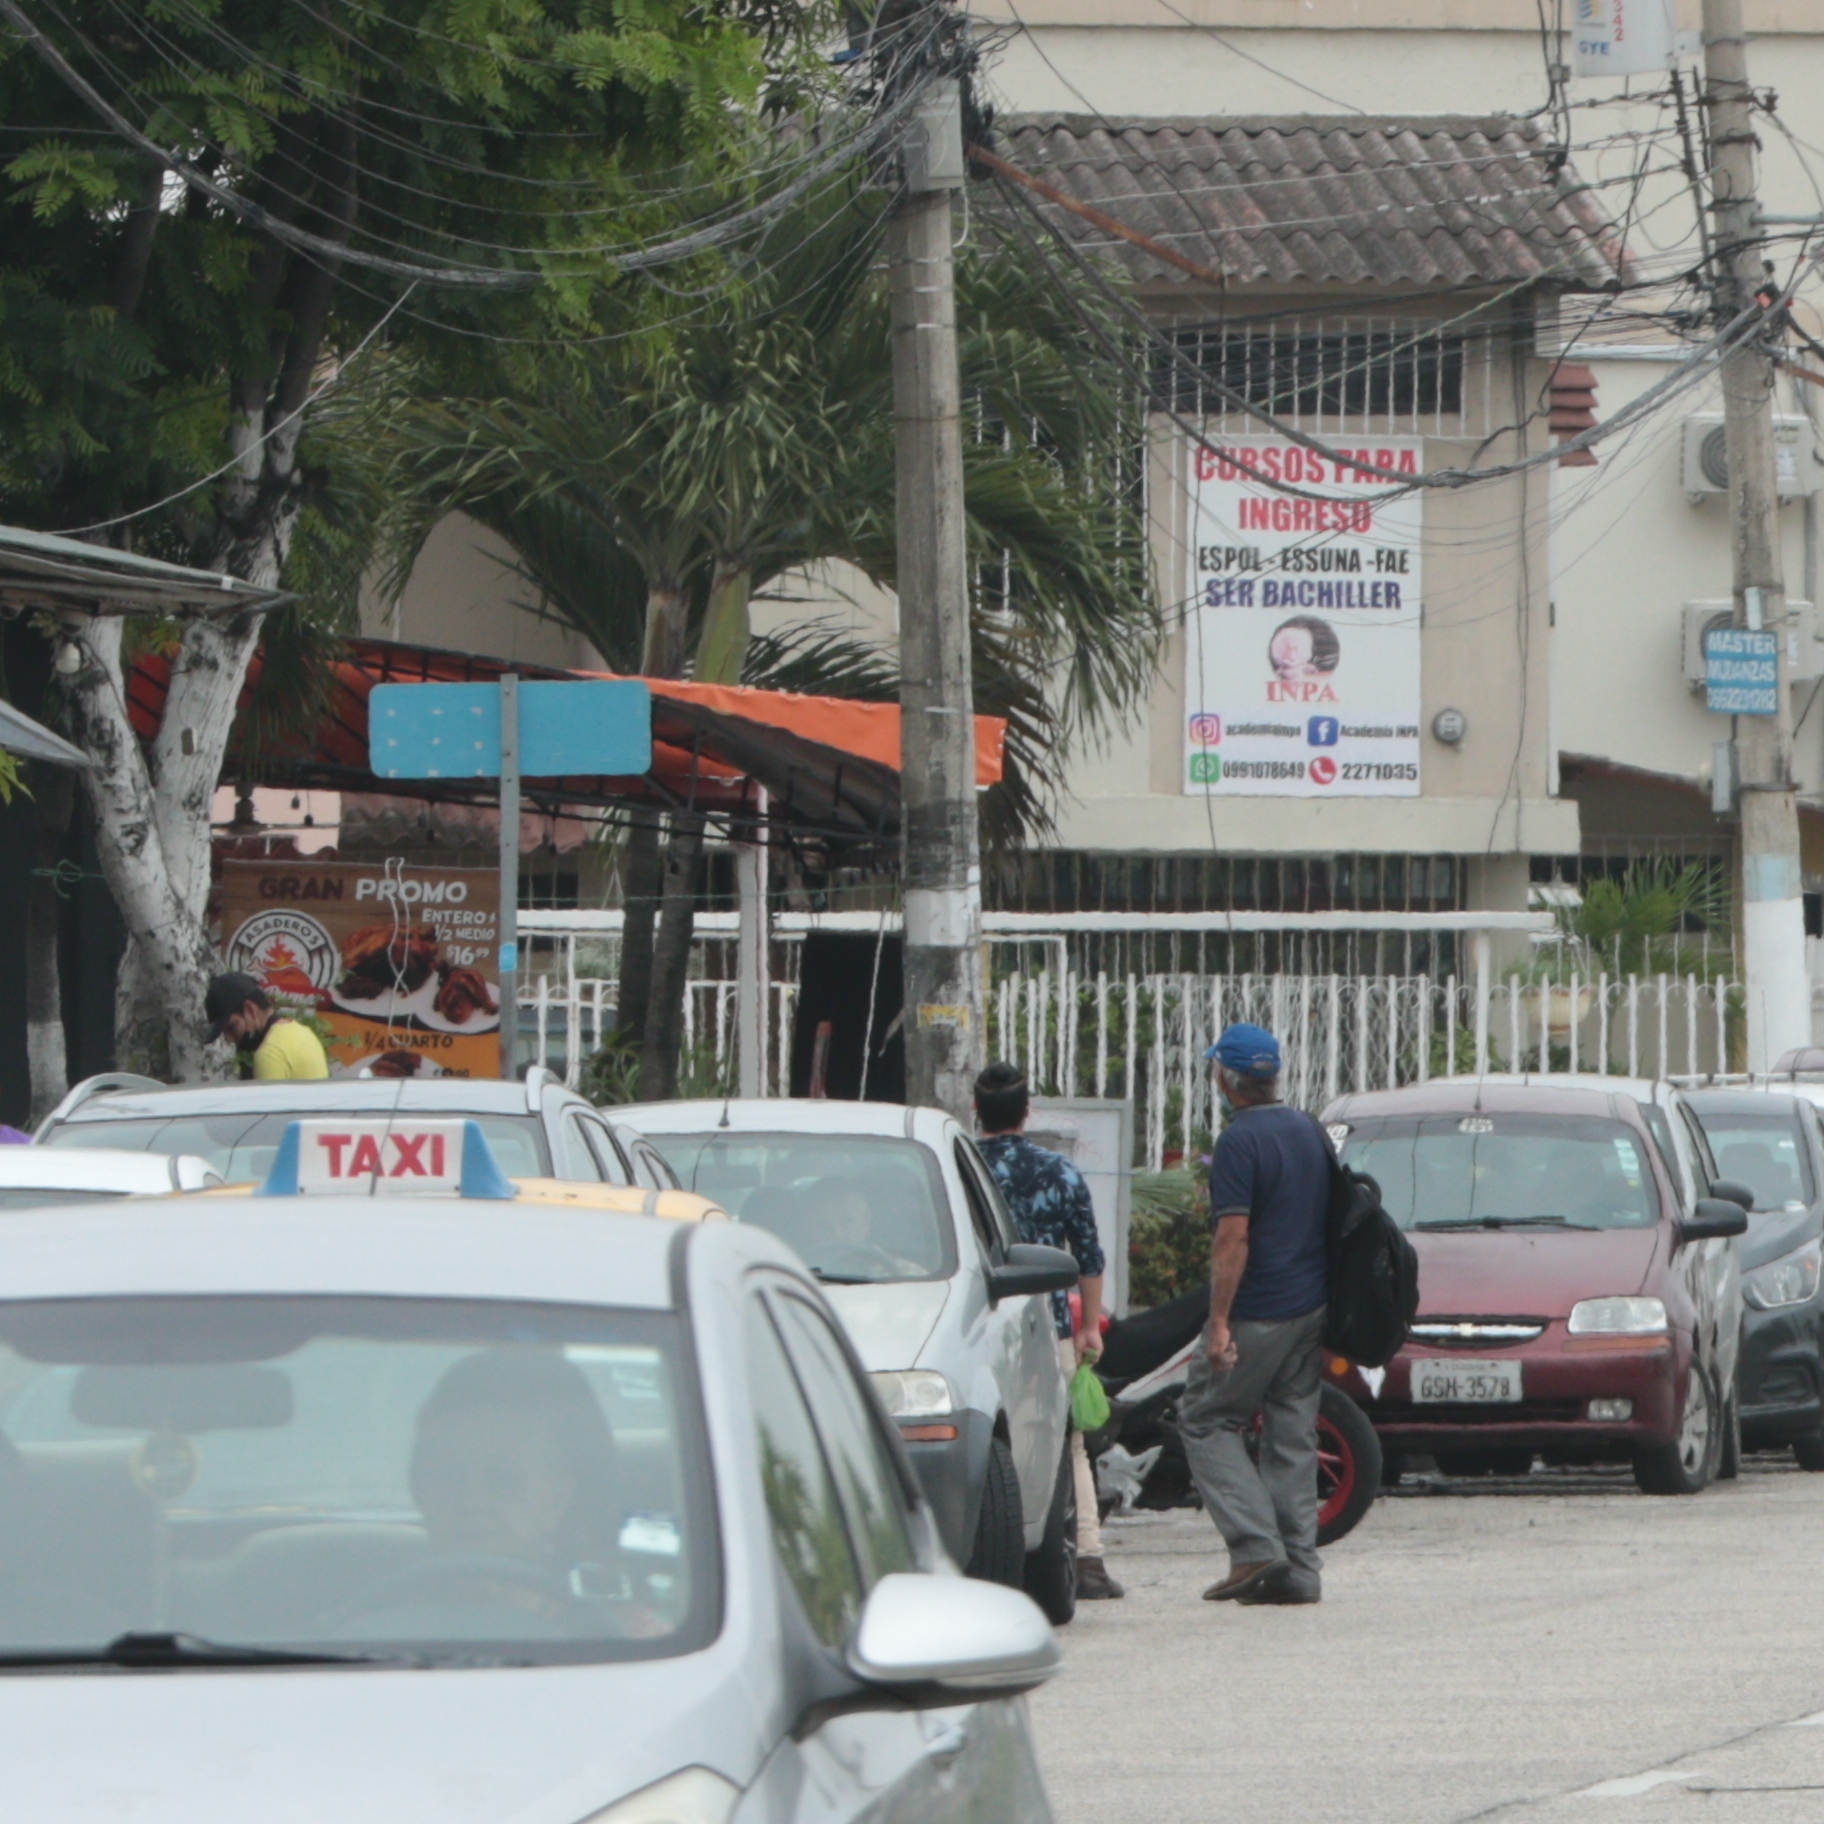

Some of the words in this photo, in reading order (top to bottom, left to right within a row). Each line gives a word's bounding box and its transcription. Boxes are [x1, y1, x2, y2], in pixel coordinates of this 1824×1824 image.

[1579, 40, 1610, 55] GYE
[1194, 445, 1326, 484] CURSOS
[1333, 448, 1418, 484] PARA
[1238, 498, 1372, 534] INGRESO
[1199, 545, 1264, 573] ESPOL
[1280, 547, 1362, 574] ESSUNA
[1204, 578, 1255, 608] SER
[1262, 580, 1403, 609] BACHILLER
[1707, 631, 1776, 655] MASTER
[1707, 659, 1776, 682] MUDANZAS
[1265, 680, 1340, 703] INPA
[1341, 763, 1418, 781] 2271035
[258, 876, 345, 901] GRAN
[354, 877, 468, 904] PROMO
[421, 907, 487, 925] ENTERO
[243, 914, 322, 948] ASADEROS
[434, 923, 453, 943] 1/2
[455, 927, 496, 941] MEDIO
[388, 1032, 454, 1050] CUARTO
[317, 1133, 445, 1179] TAXI
